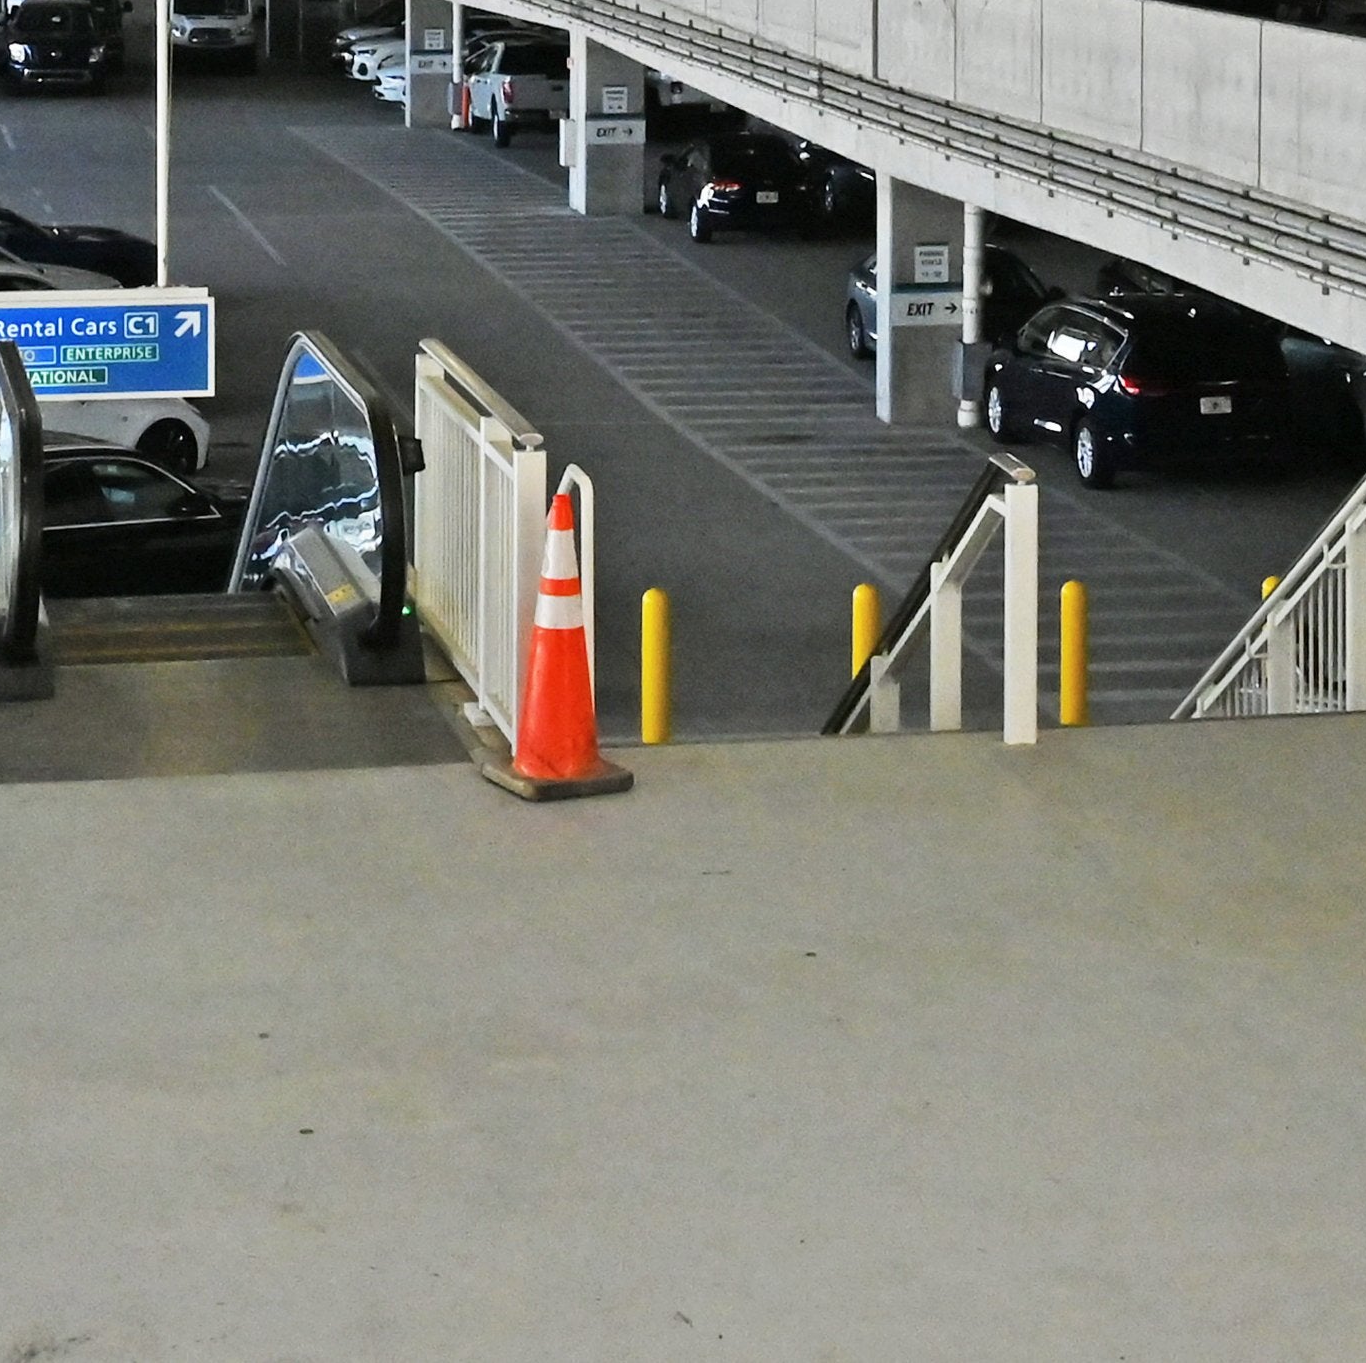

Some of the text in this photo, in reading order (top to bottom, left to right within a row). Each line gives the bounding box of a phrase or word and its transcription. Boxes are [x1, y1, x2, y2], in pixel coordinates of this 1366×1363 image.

[906, 302, 935, 317] EXIT
[67, 316, 117, 337] Cars
[128, 314, 156, 335] C1
[66, 345, 153, 361] ENTERPRISE
